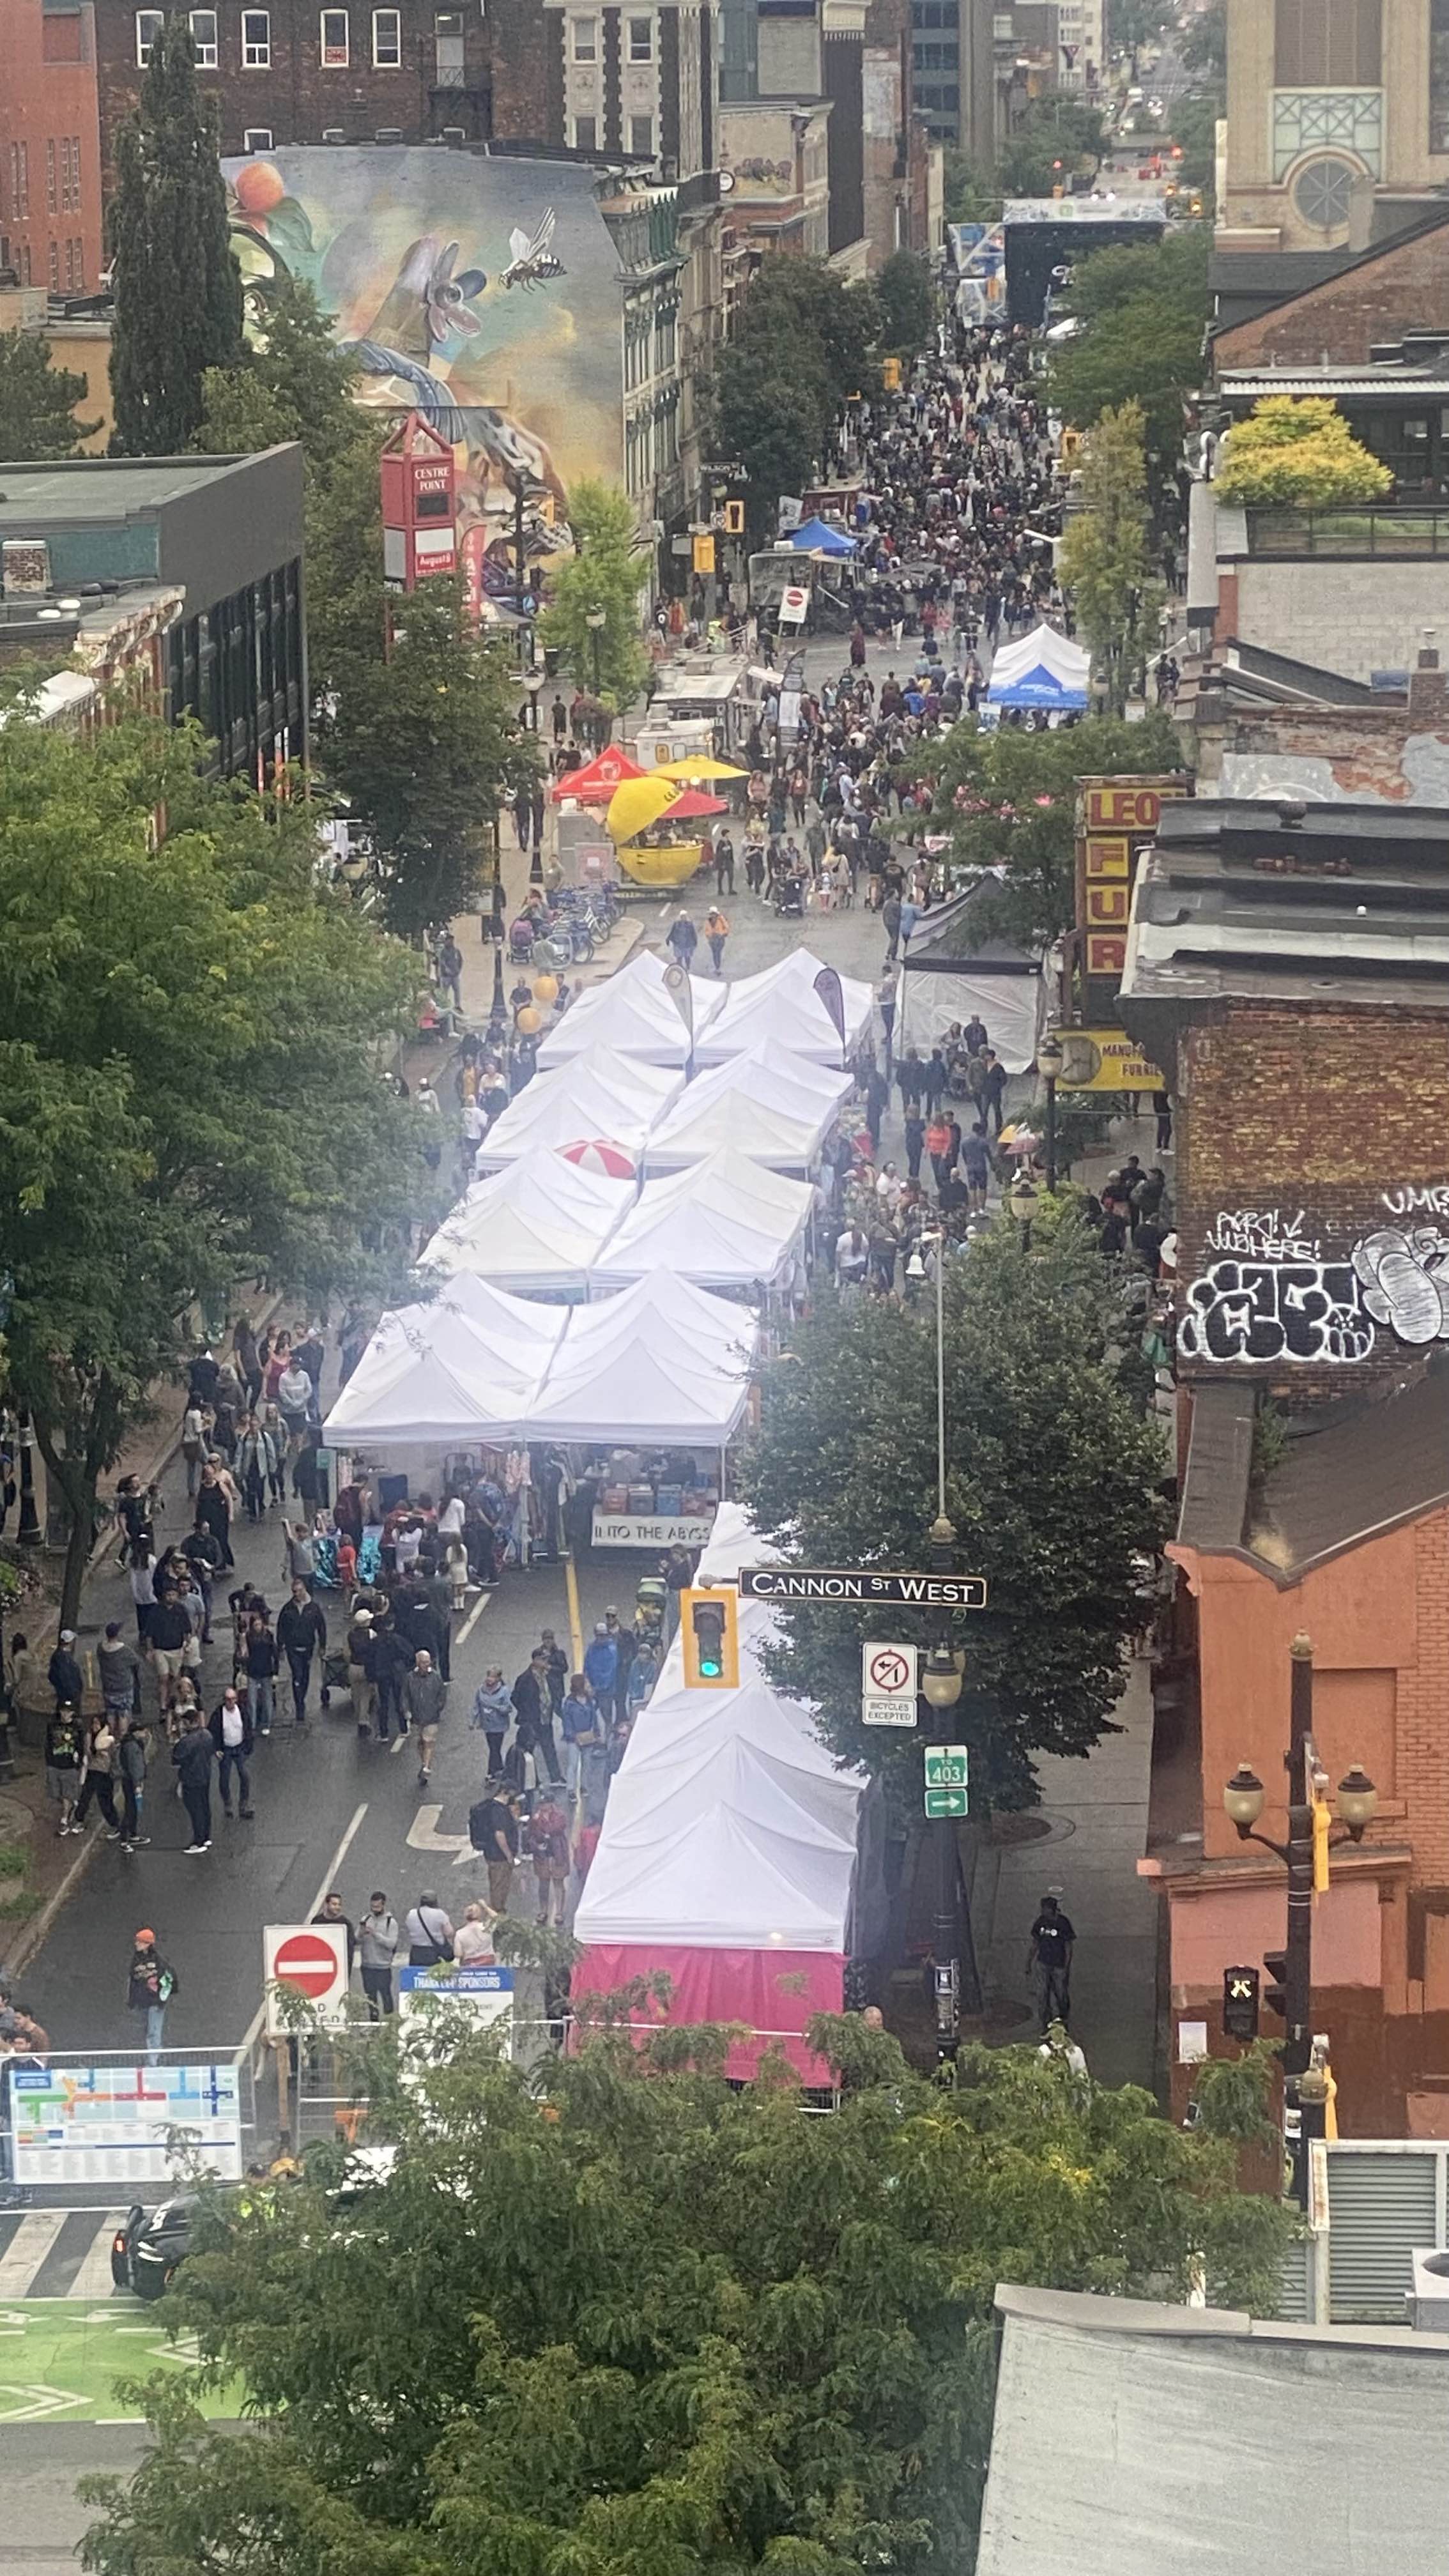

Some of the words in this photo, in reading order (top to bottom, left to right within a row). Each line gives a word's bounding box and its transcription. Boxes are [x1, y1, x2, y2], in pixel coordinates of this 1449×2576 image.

[415, 466, 450, 479] CENTRE
[420, 479, 445, 491] POINT
[1091, 792, 1184, 825] LEO
[636, 1526, 661, 1539] THE
[751, 1573, 862, 1597] CANNON
[899, 1579, 974, 1602] WEST
[870, 1702, 909, 1711] BICYCLES
[868, 1711, 911, 1721] EXCEPTED
[932, 1766, 961, 1782] 403
[458, 1976, 500, 1989] SPONSORS
